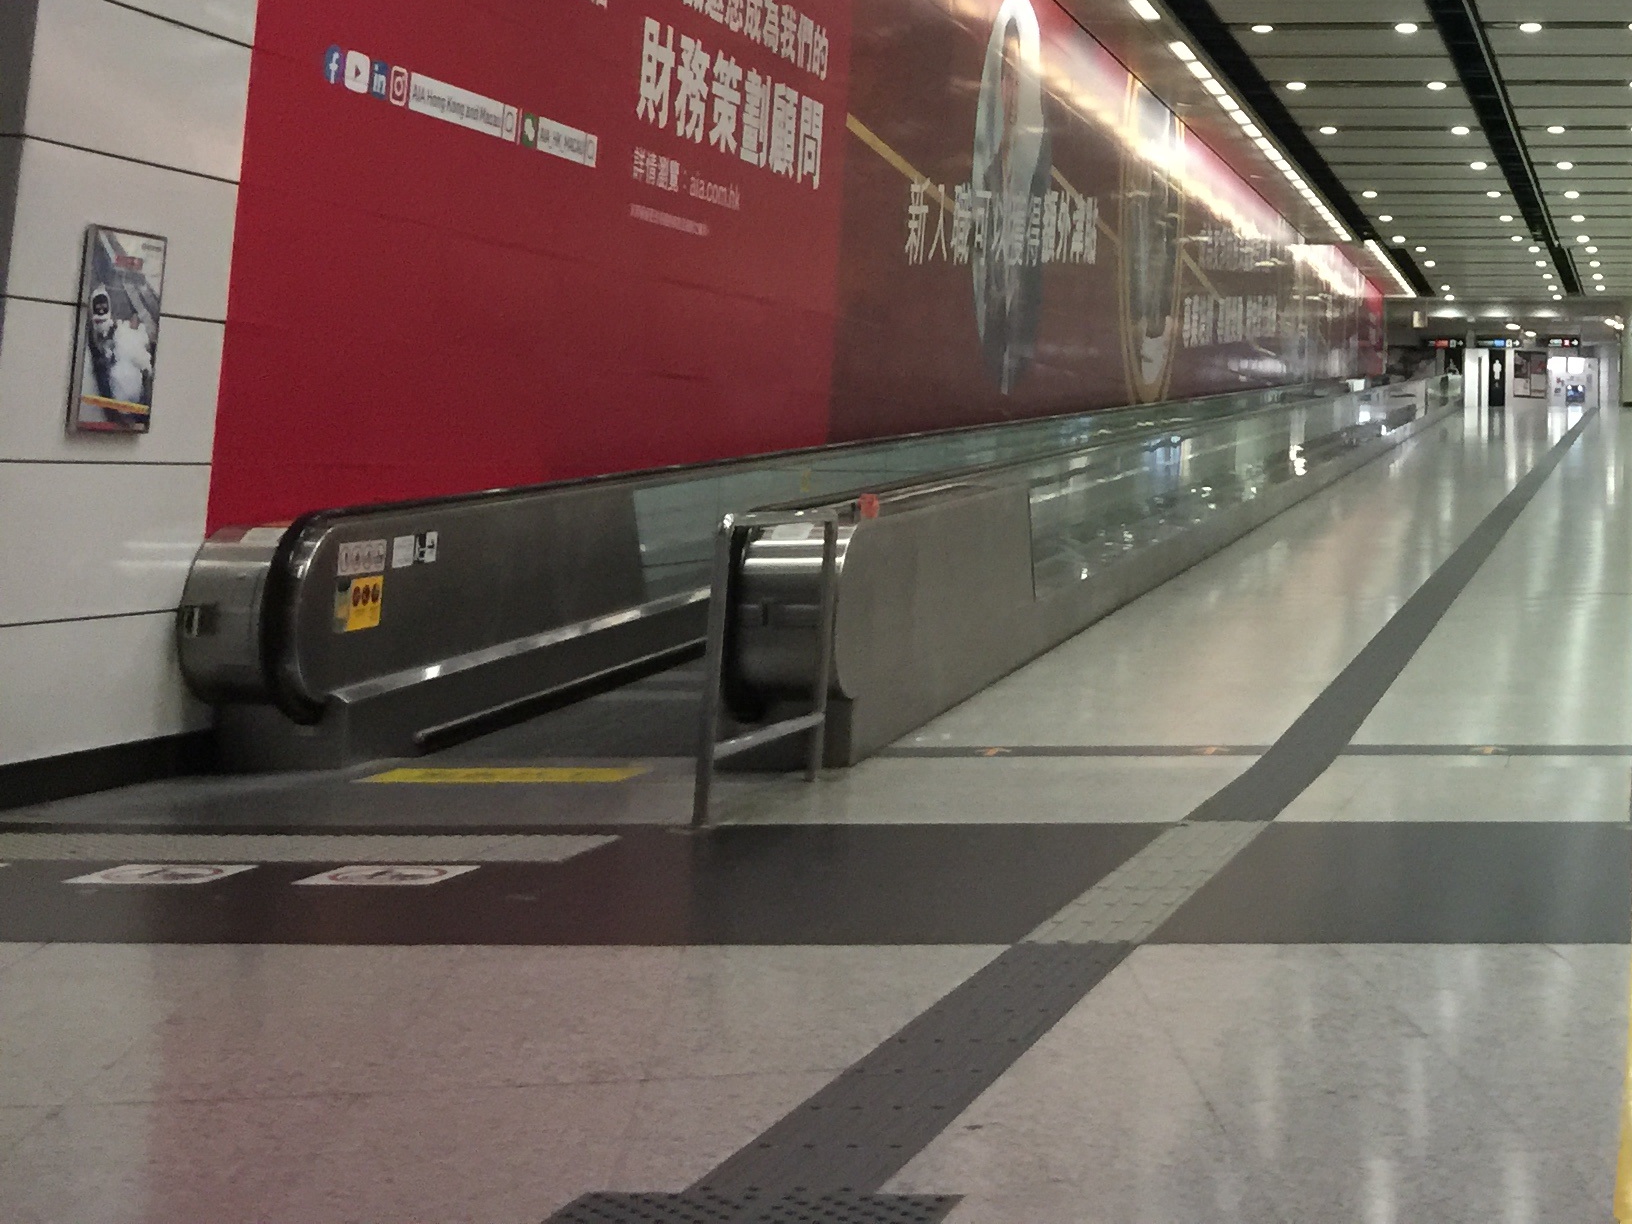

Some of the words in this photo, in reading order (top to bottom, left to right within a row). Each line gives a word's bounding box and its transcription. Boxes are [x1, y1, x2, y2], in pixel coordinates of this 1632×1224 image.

[636, 17, 824, 190] 財務策劃顧問
